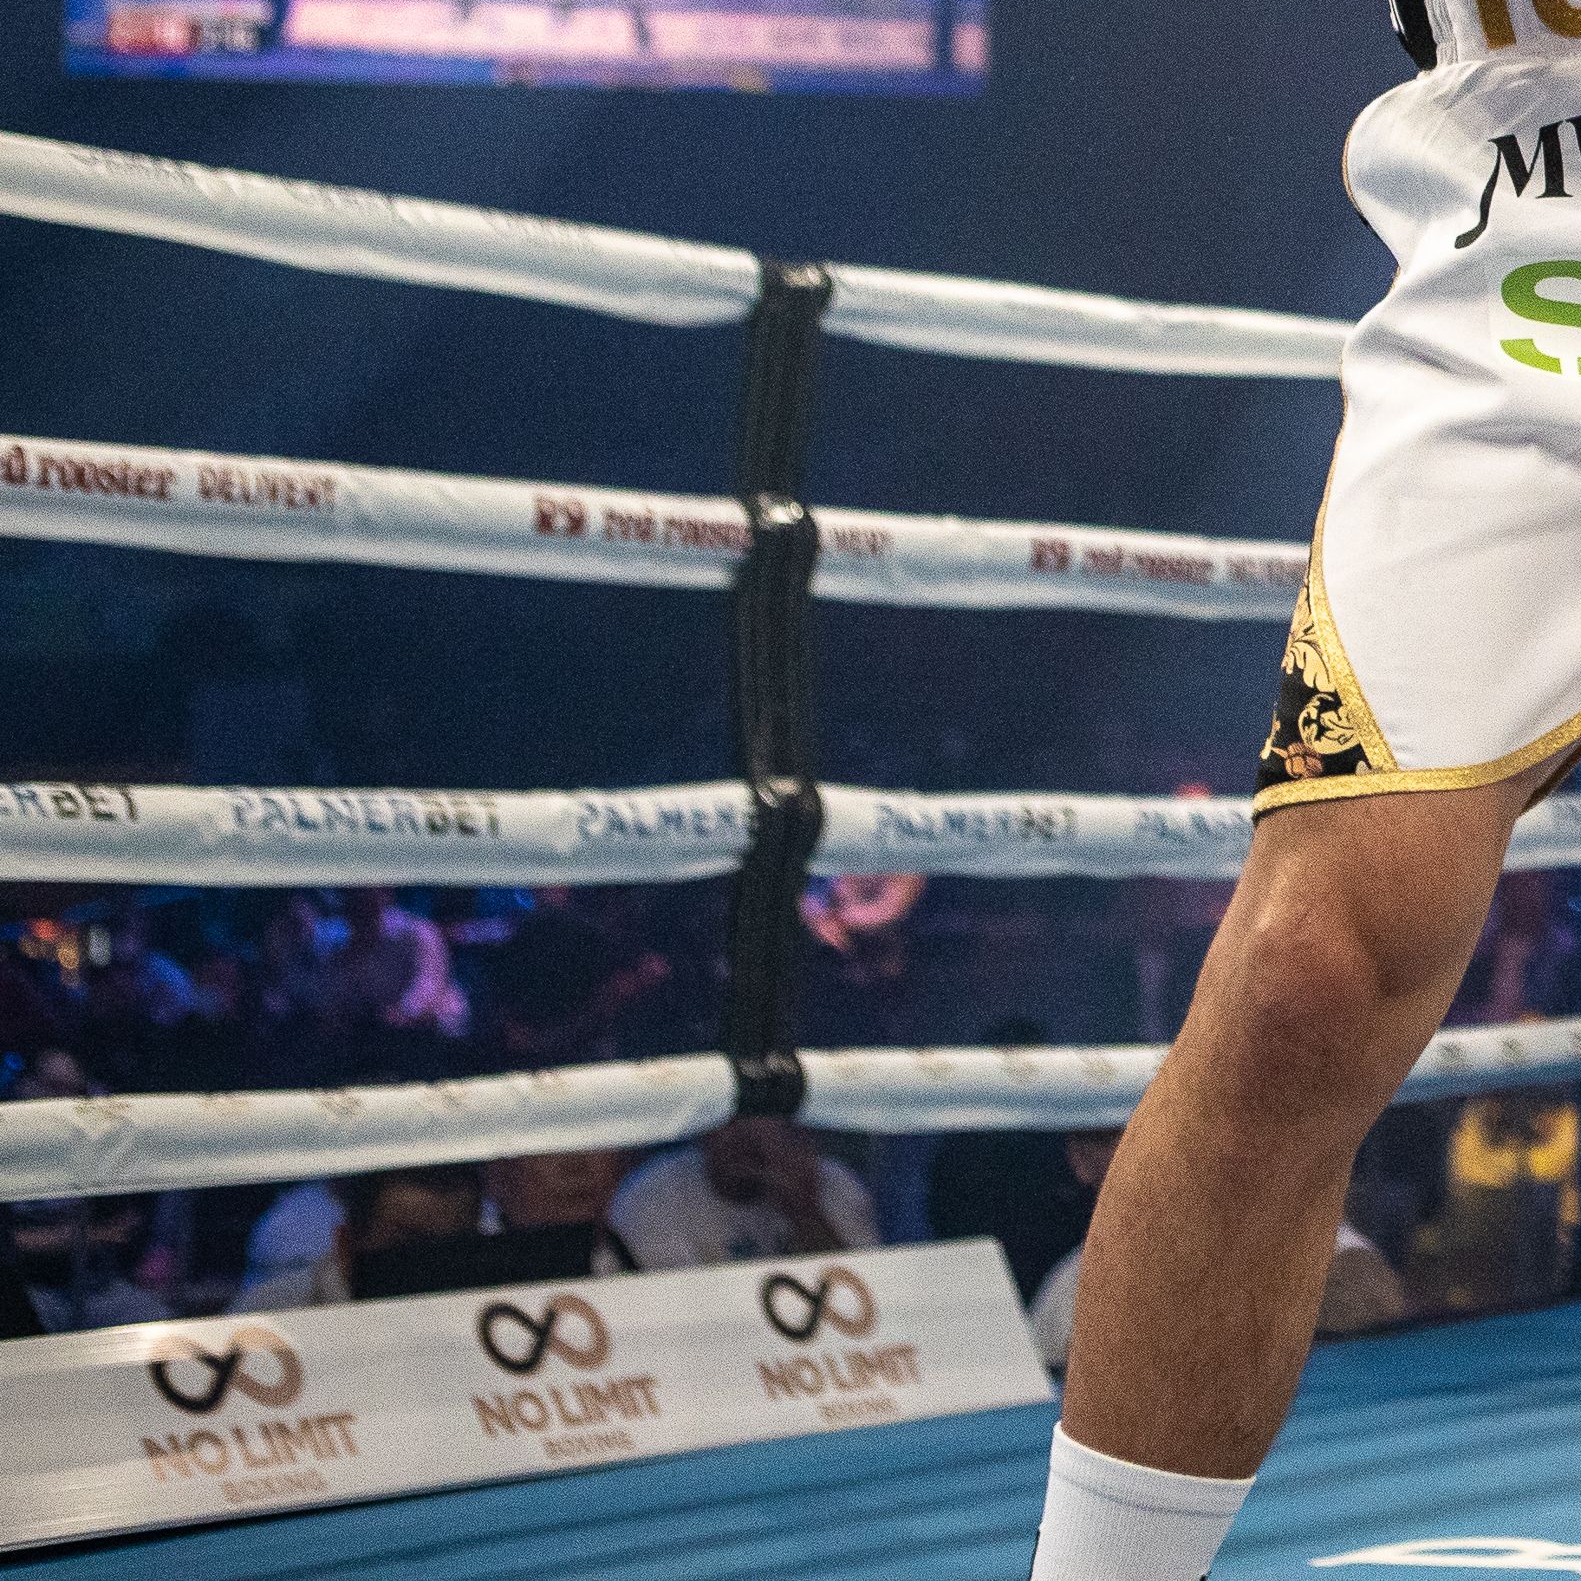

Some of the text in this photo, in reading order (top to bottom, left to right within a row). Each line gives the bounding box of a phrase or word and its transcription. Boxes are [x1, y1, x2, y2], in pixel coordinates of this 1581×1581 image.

[758, 1343, 922, 1401] NO LIMIT
[471, 1375, 662, 1437] NO LIMIT
[140, 1412, 358, 1483] NO LIMIT
